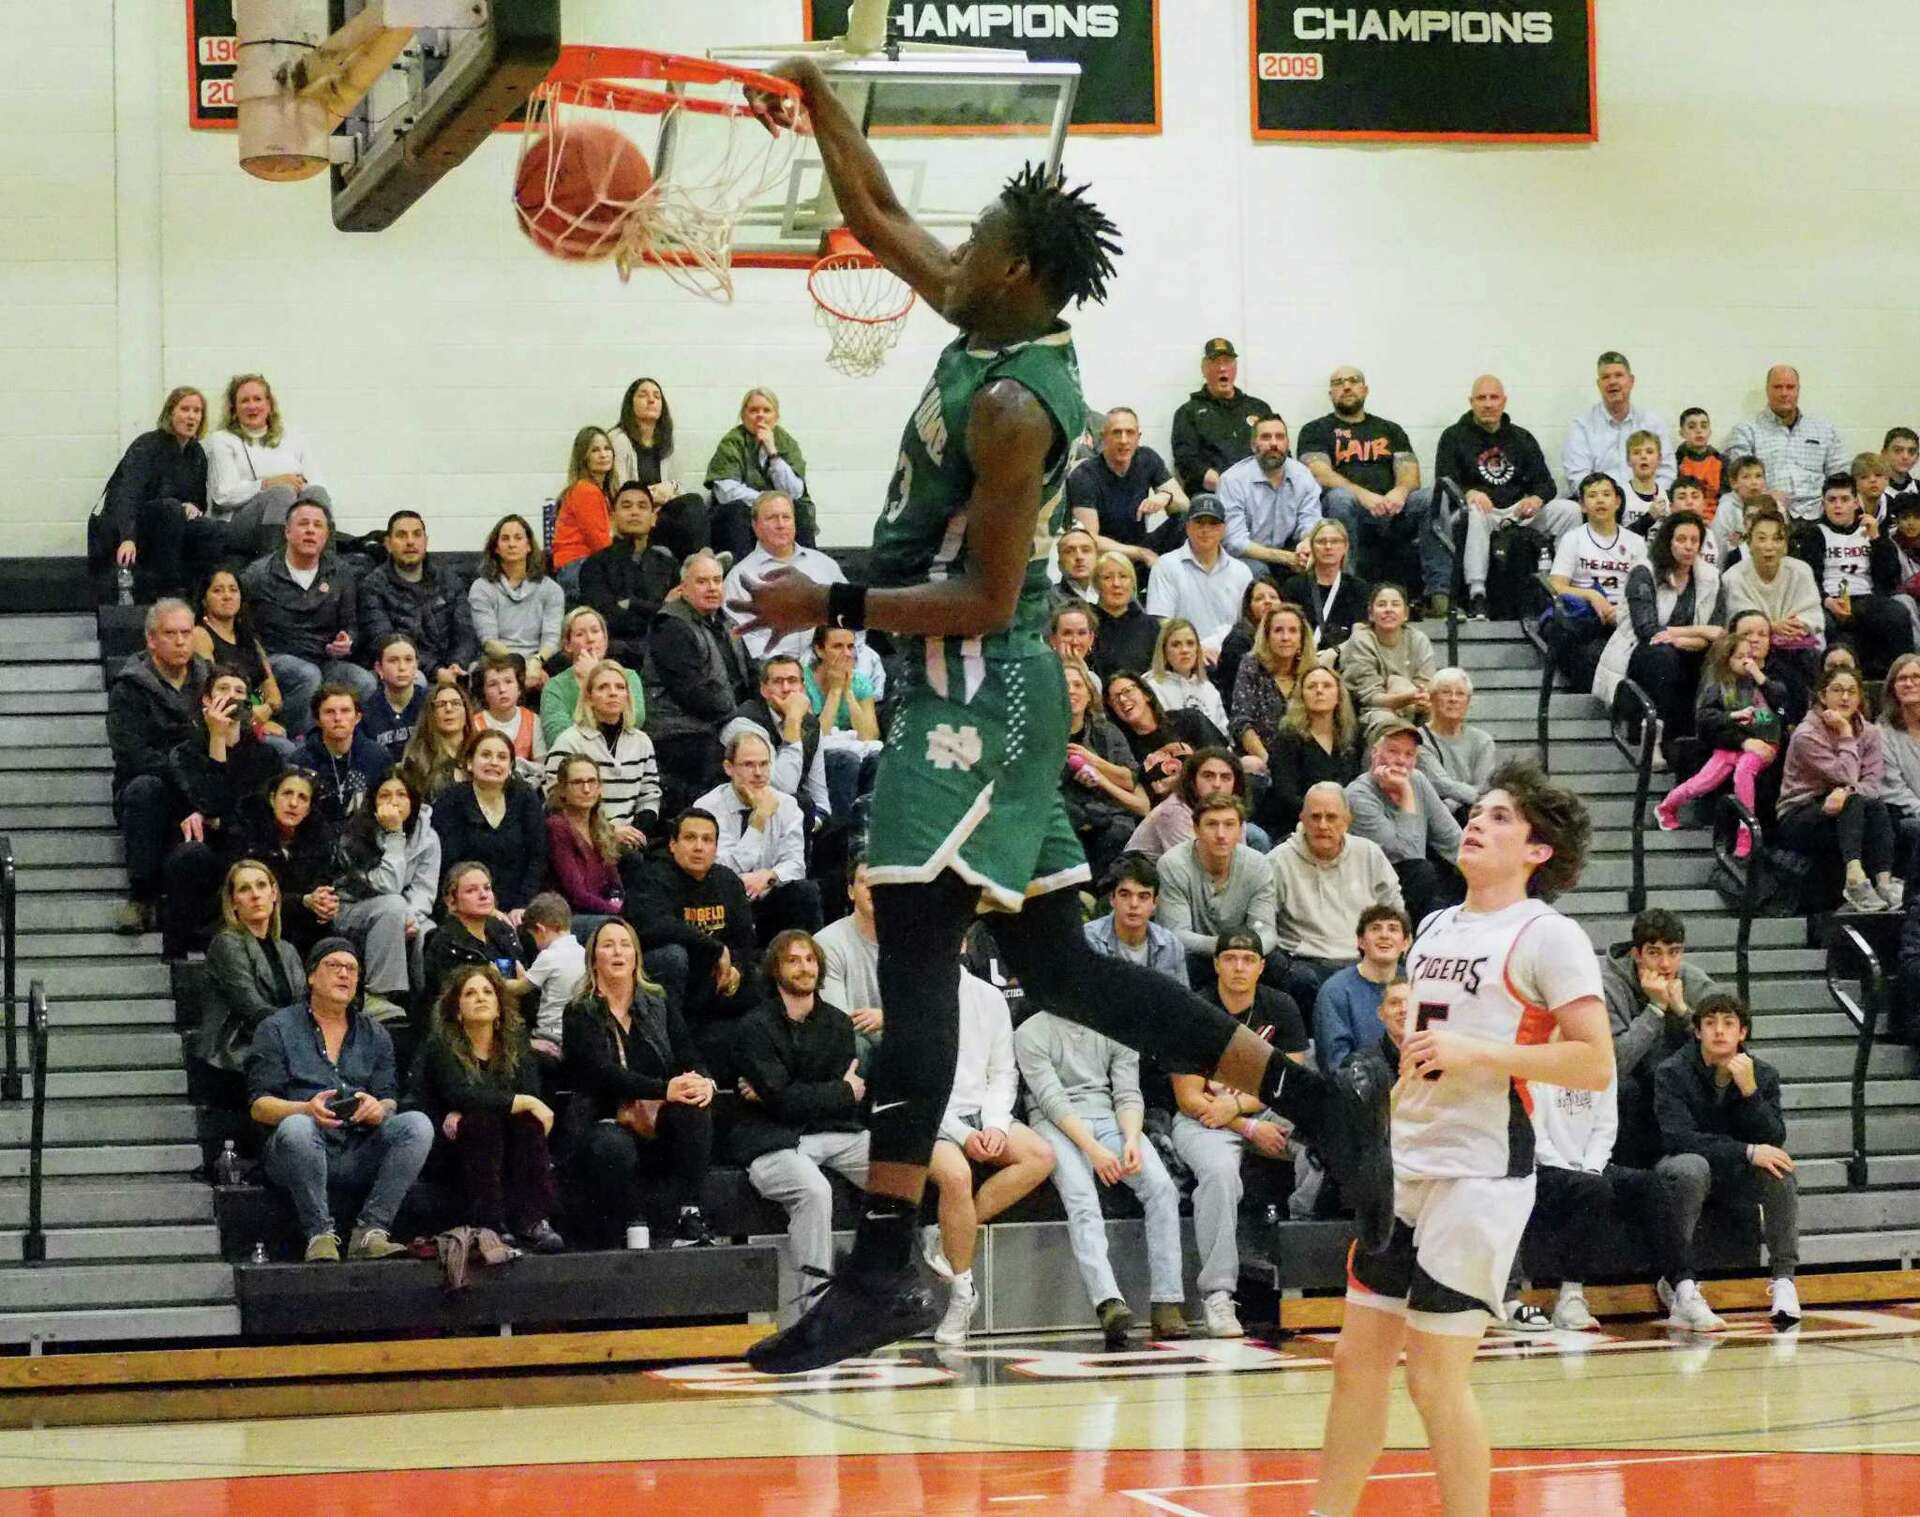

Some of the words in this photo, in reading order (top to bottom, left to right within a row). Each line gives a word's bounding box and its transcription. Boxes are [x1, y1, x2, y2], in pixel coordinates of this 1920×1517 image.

[848, 4, 1119, 38] HAMPIONS
[1293, 7, 1553, 44] CHAMPIONS
[1263, 56, 1318, 77] 2009
[1335, 436, 1392, 466] LAIR
[1579, 557, 1599, 570] THE
[1411, 954, 1488, 995] TIGERS
